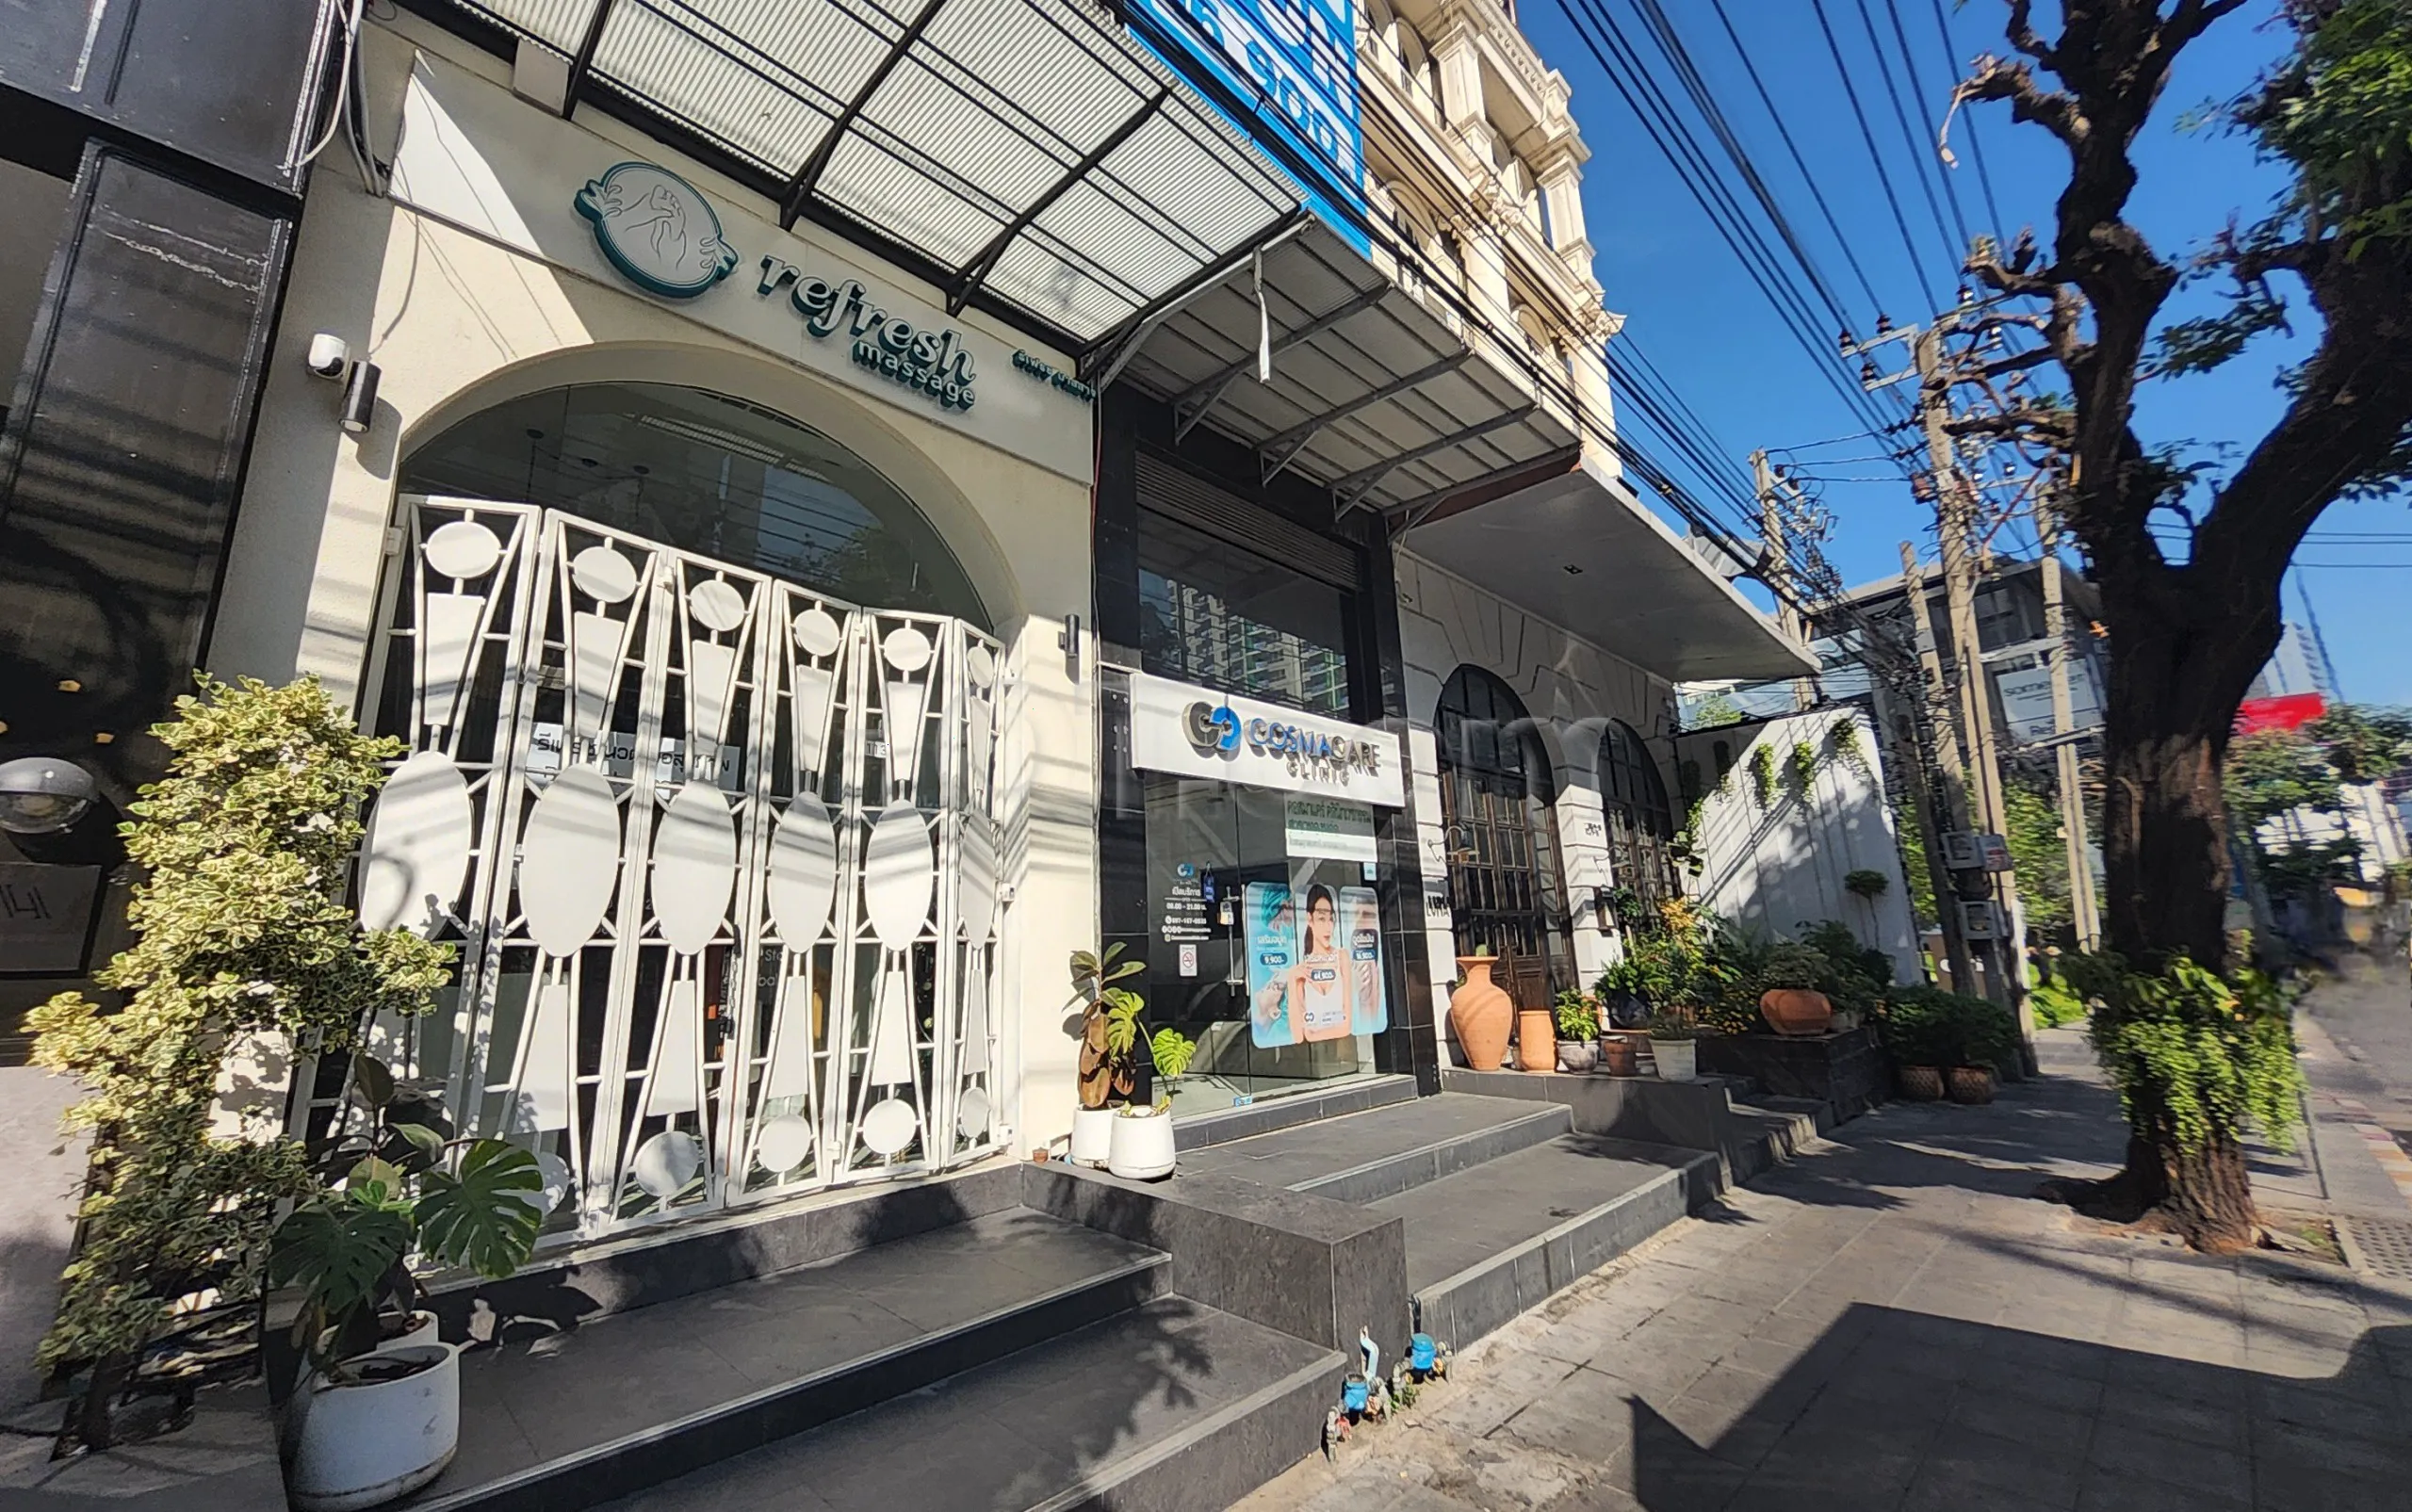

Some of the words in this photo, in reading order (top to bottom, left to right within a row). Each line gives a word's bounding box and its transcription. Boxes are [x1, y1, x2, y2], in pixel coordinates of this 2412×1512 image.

[758, 254, 977, 386] refresh
[853, 340, 976, 411] massage
[1244, 717, 1381, 769] COSMACARE
[1286, 760, 1349, 785] CLINIC
